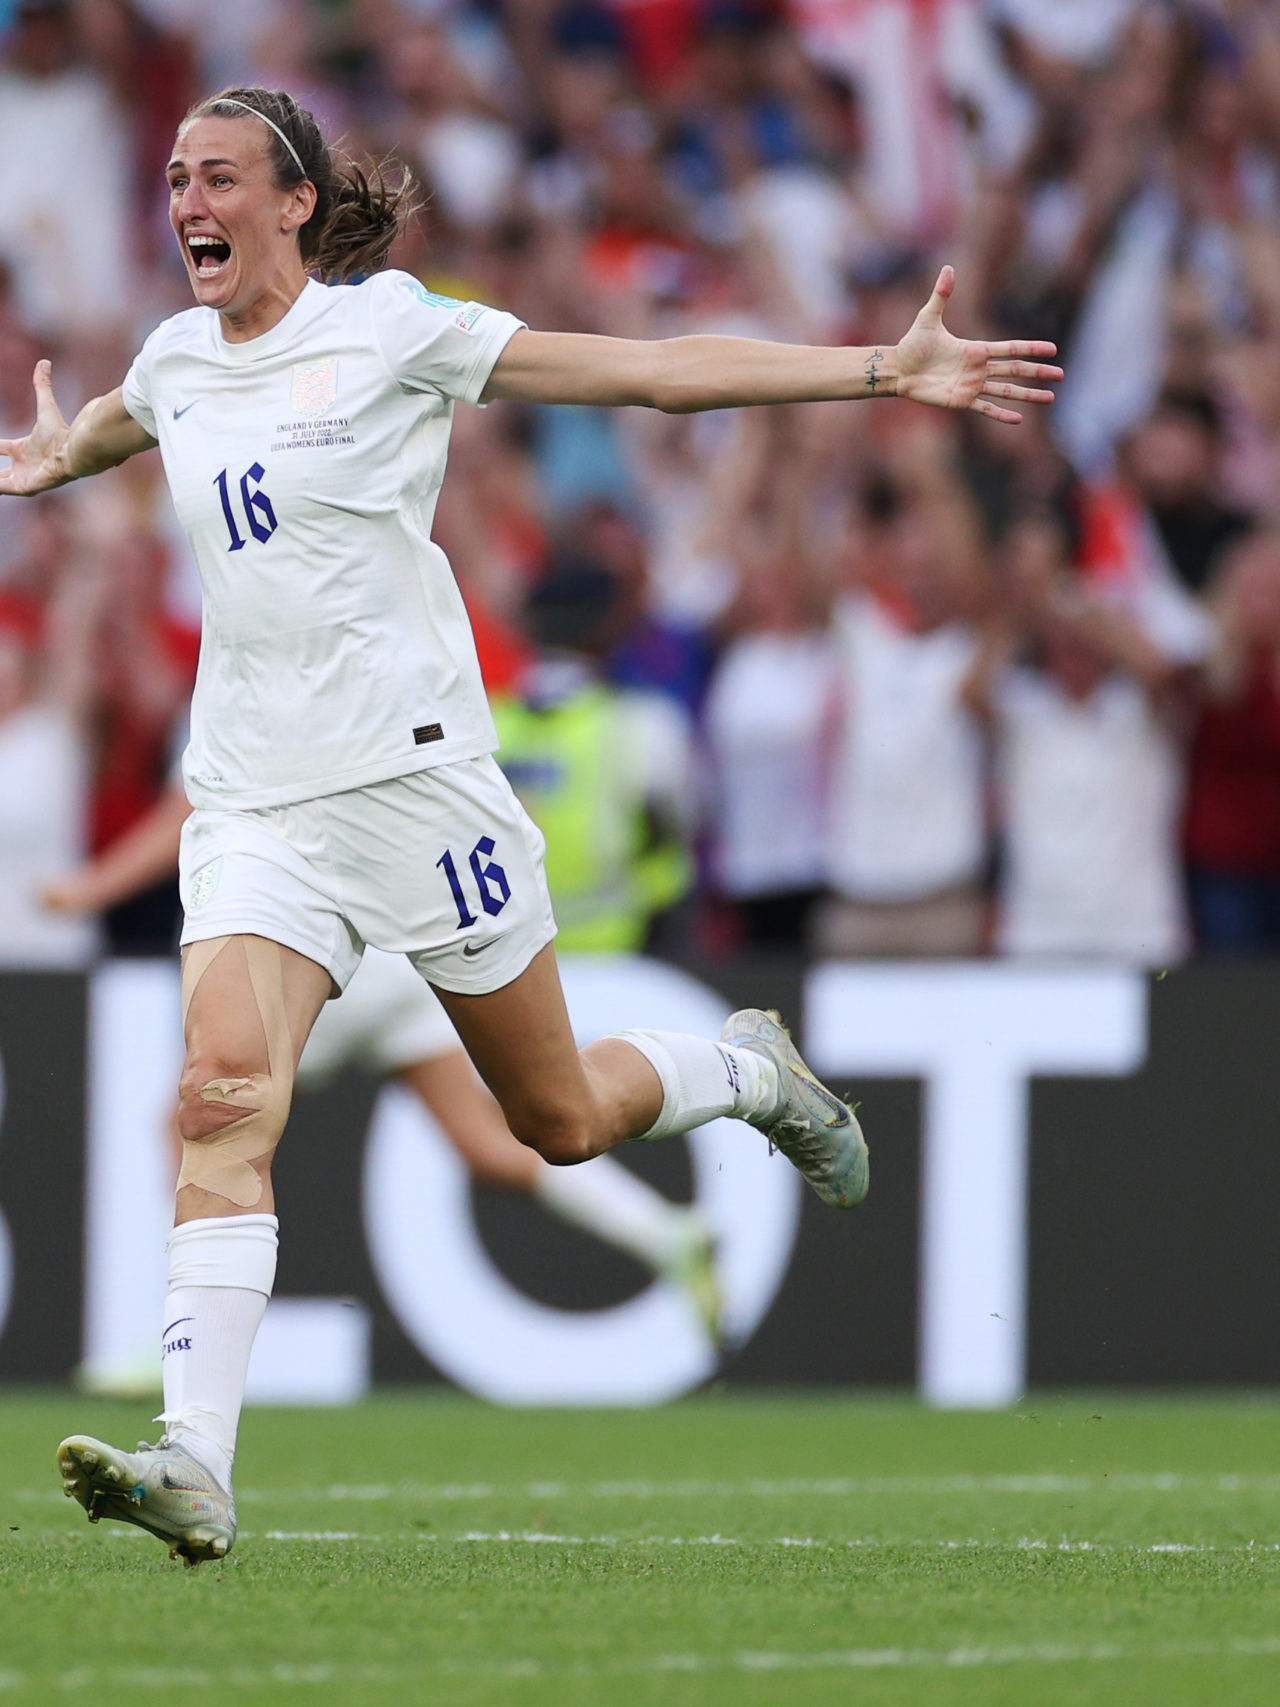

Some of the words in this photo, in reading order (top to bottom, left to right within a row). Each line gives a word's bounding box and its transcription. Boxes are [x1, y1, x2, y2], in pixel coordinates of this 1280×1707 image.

[276, 422, 307, 433] ENGLAND
[308, 420, 313, 429] V
[314, 418, 349, 429] GERMANY
[300, 430, 316, 439] JULY
[271, 442, 286, 452] UEFA
[286, 439, 316, 450] WOMENS
[316, 437, 335, 447] EURO
[335, 435, 356, 445] FINAL
[213, 462, 278, 552] 16
[436, 835, 511, 930] 16
